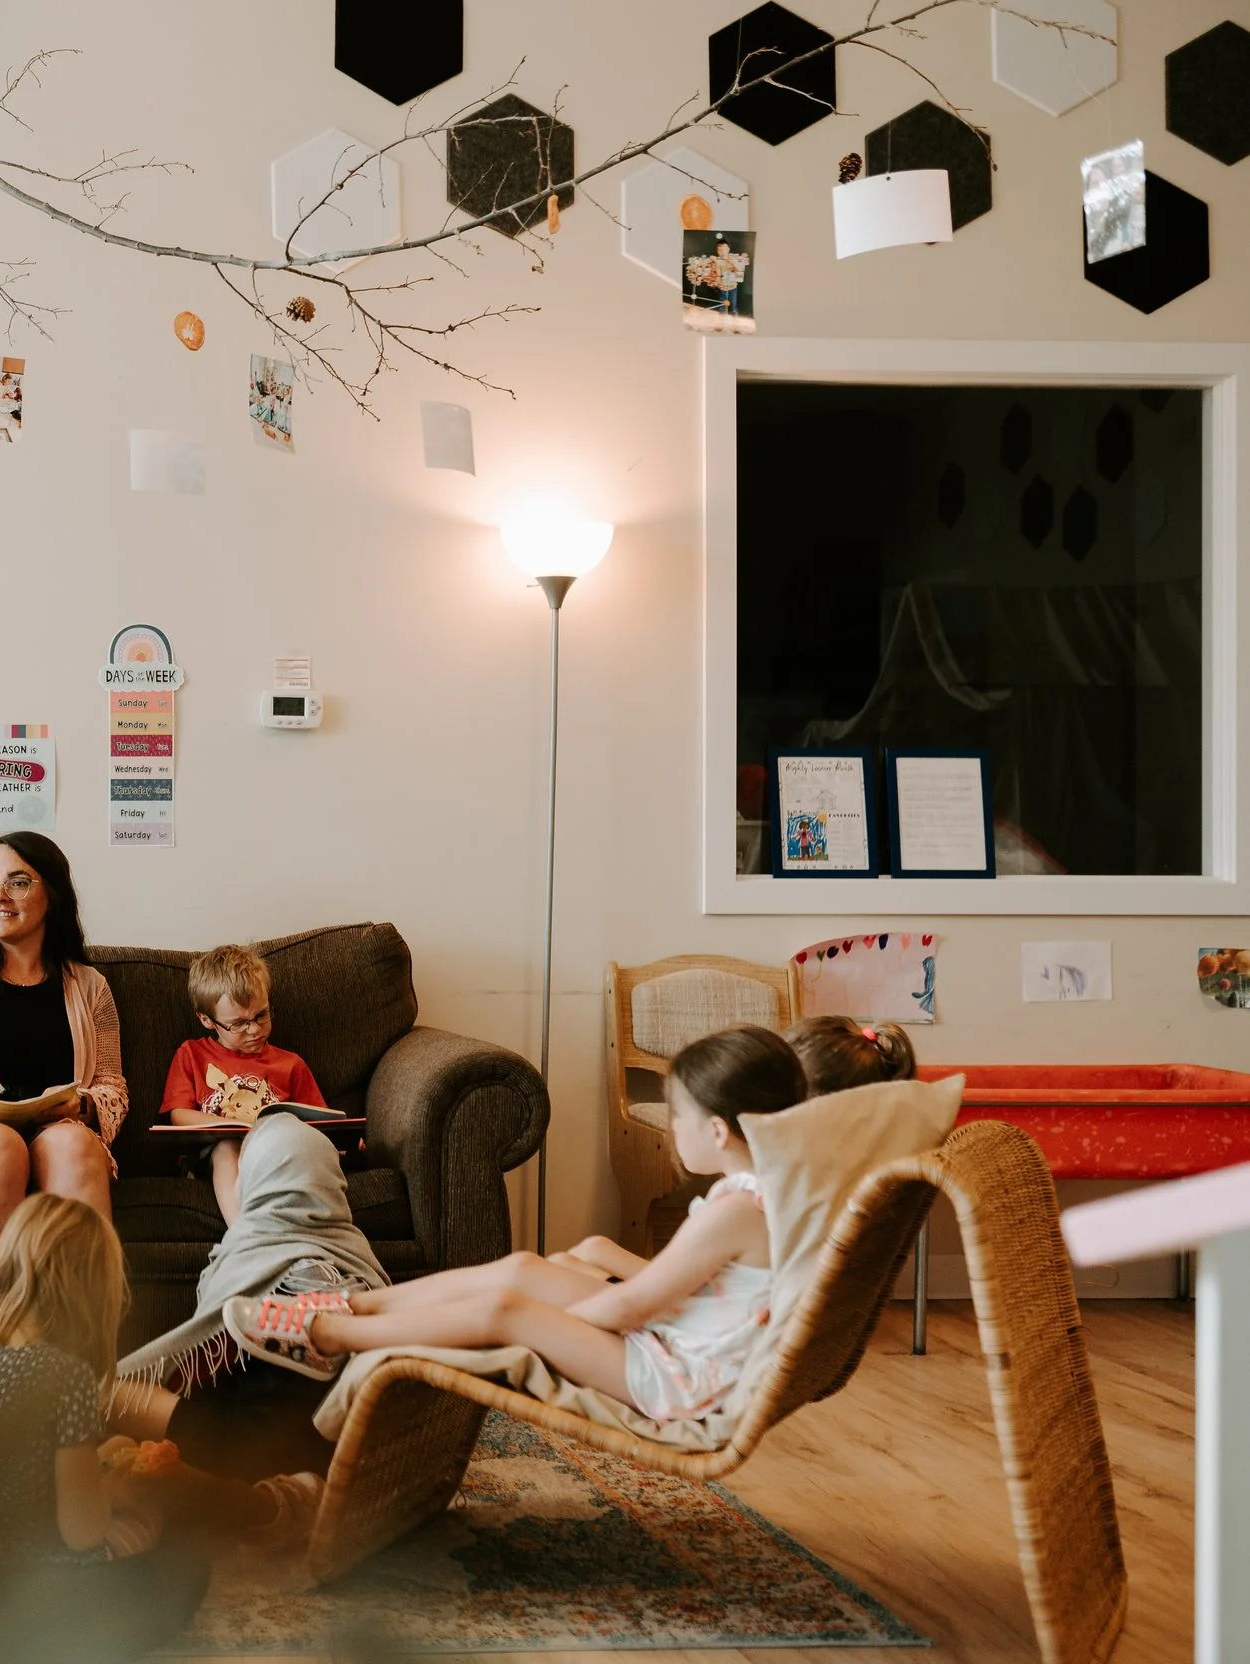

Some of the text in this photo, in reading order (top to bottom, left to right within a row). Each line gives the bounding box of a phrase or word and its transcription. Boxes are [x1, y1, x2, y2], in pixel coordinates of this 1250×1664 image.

[106, 670, 134, 683] DAYS
[146, 670, 177, 683] WEEK
[118, 698, 148, 708] Sunday
[118, 721, 148, 730] Monday
[30, 746, 37, 754] is
[117, 742, 149, 752] Tuesday
[114, 765, 152, 774] Wednesday
[34, 784, 42, 792] is
[120, 809, 146, 819] Friday
[114, 831, 151, 840] Saturday
